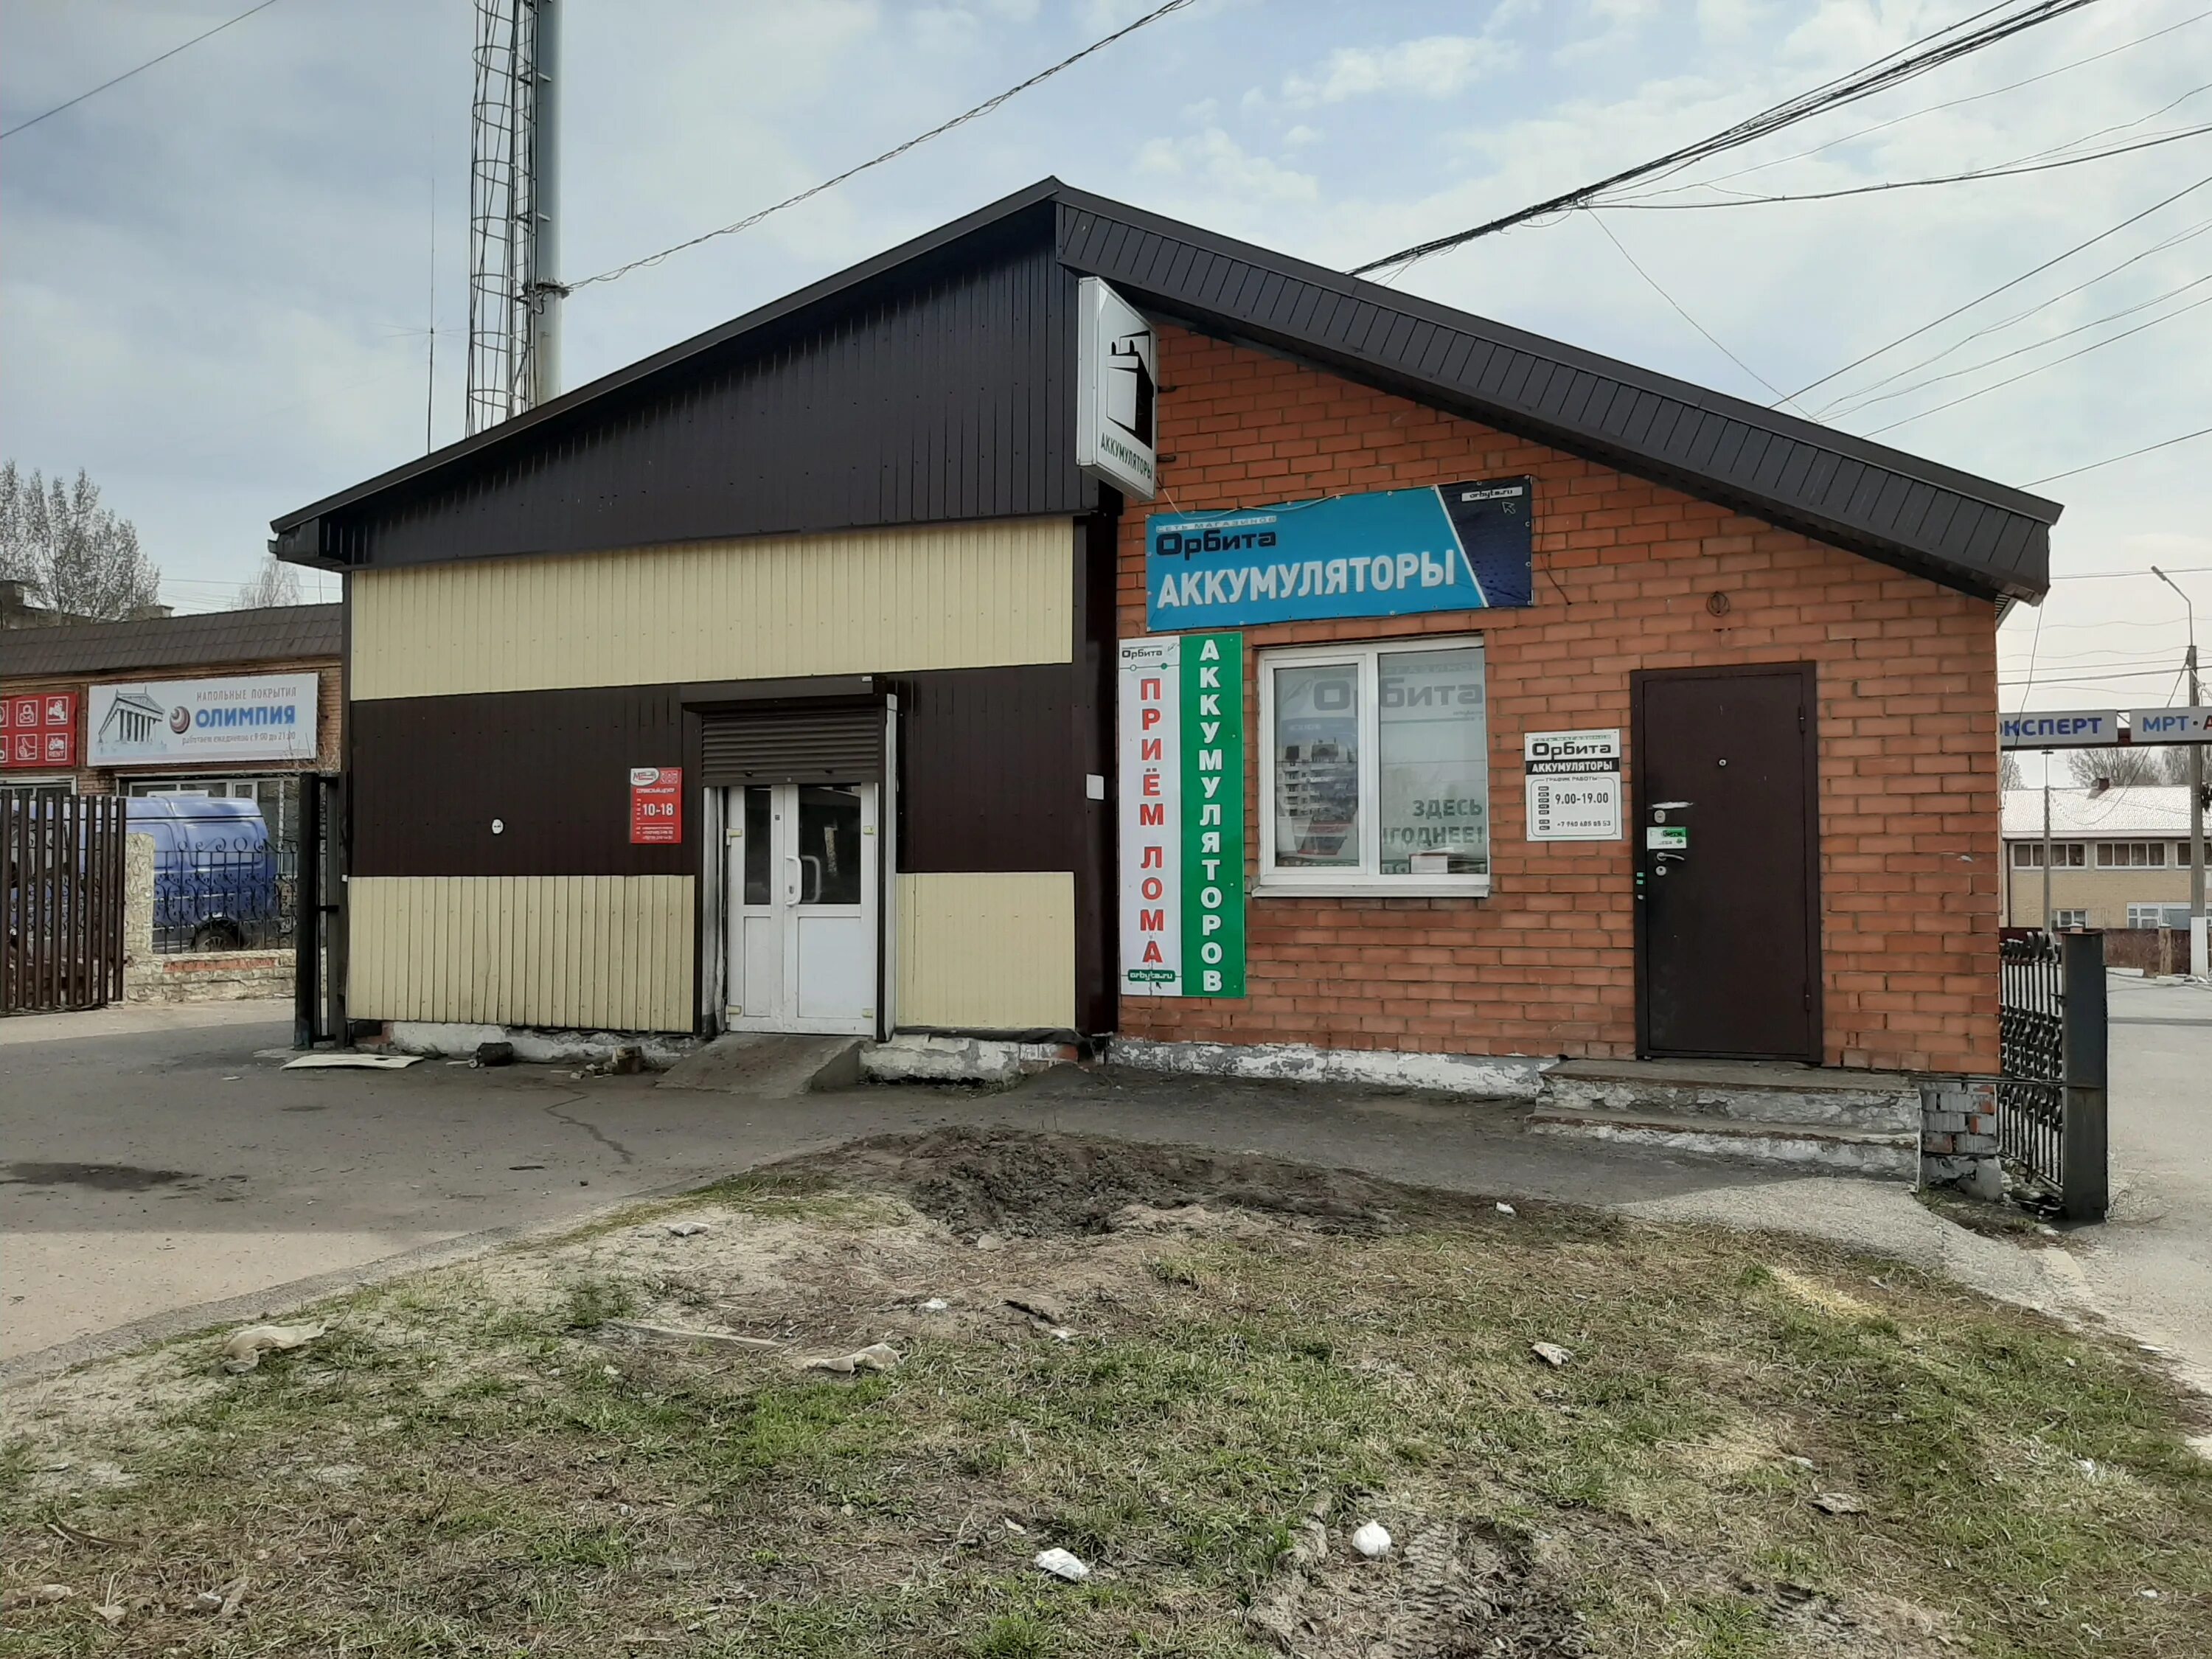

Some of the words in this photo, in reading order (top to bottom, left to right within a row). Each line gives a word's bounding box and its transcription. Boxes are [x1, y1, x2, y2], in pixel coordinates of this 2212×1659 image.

[1101, 432, 1153, 481] АККУМУЛЯТОРЫ
[1194, 517, 1276, 529] МАГАЗИНОВ
[1156, 529, 1276, 560] Орбита
[1157, 549, 1455, 609] АККУМУЛЯТОРЫ
[1121, 649, 1163, 660] Орбита
[196, 689, 247, 701] НАПОЛЬНЫЕ
[251, 686, 296, 699] ПОКРЫТИЯ
[1313, 678, 1483, 717] Обита
[195, 705, 296, 728] ОЛИМПИЯ
[2143, 715, 2189, 732] МРТ
[2000, 717, 2102, 737] КСПЕРТ
[1139, 678, 1164, 826] ПРИЁМ
[1532, 741, 1611, 760] Орбита
[1531, 761, 1613, 773] АККУМУЛЯТОРЫ
[1555, 793, 1609, 804] 9.00-19.00
[642, 803, 673, 816] 10-18
[1199, 639, 1223, 992] АККУМУЛЯТОРОВ
[1412, 799, 1483, 820] ЗДЕСЬ
[1140, 846, 1164, 963] ЛОМА
